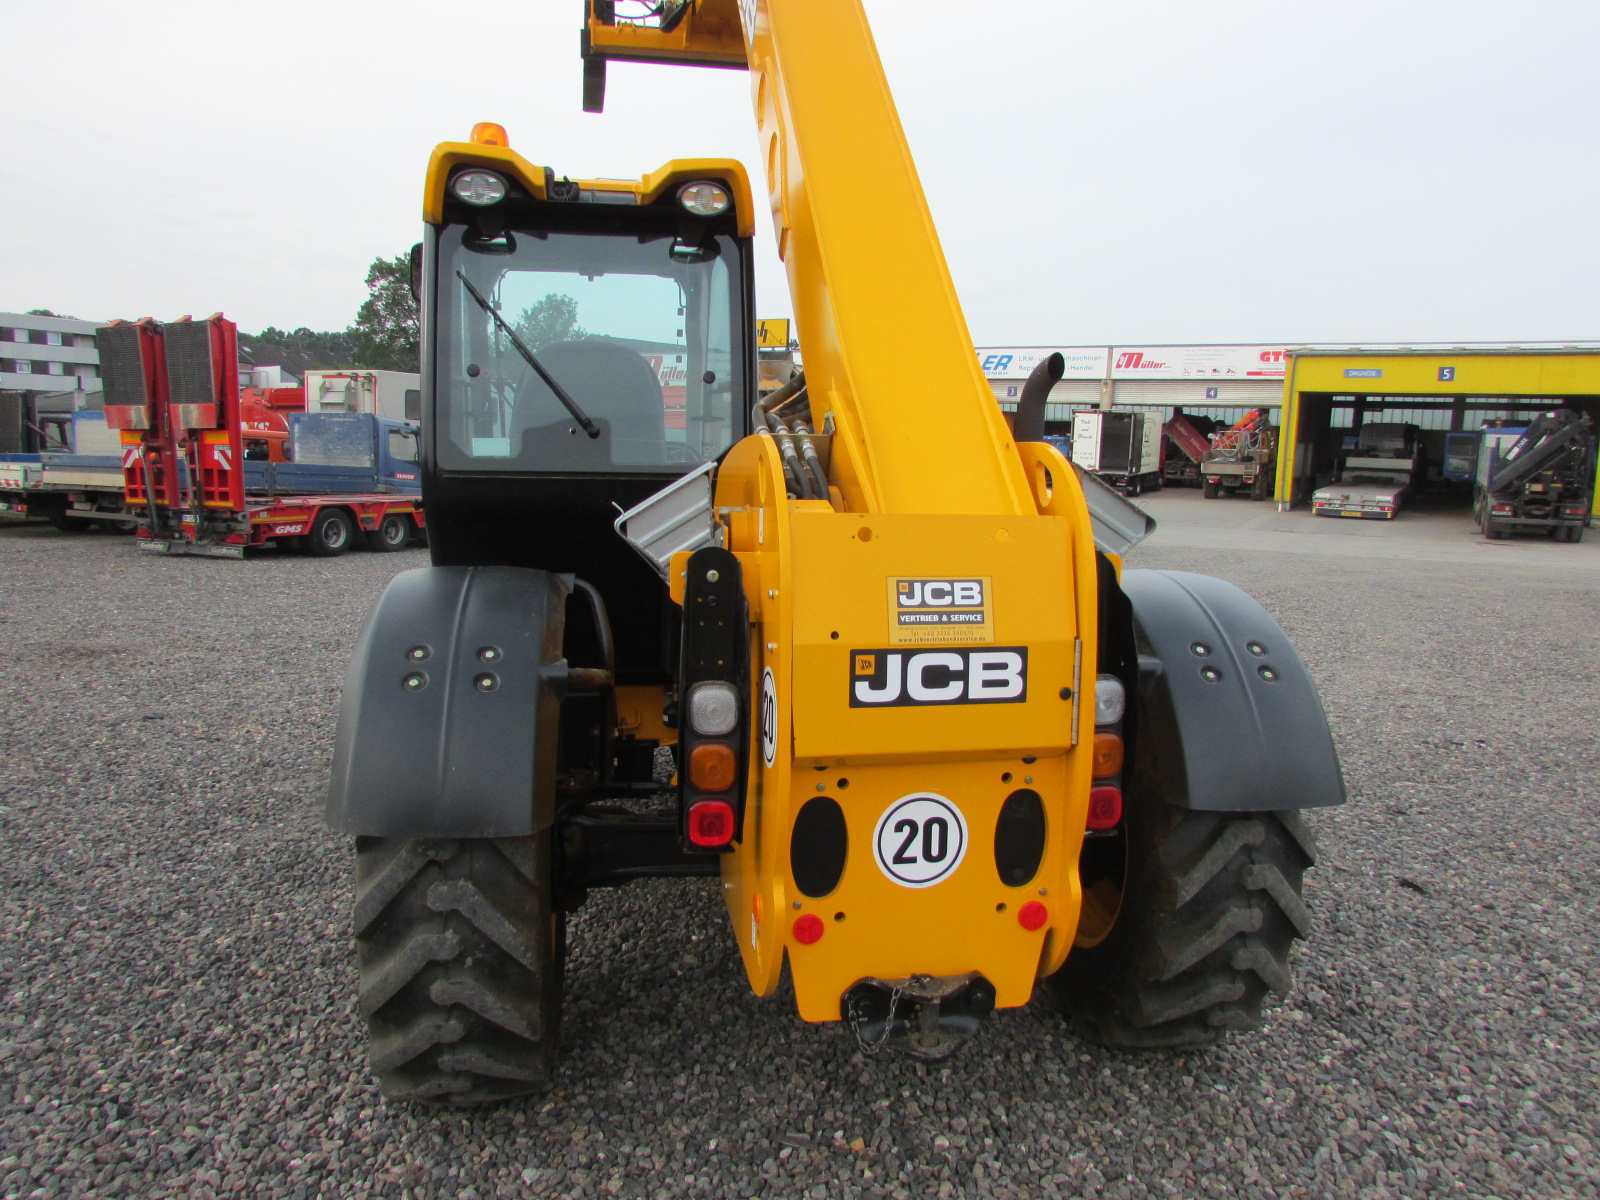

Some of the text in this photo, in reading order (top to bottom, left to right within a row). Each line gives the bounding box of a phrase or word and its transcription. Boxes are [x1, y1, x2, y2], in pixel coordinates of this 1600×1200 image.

[1115, 352, 1166, 369] Müller
[1442, 368, 1450, 380] 5
[275, 524, 303, 534] GMS
[211, 547, 240, 555] Goldhofer
[899, 582, 982, 606] JCB
[899, 614, 983, 622] VERTRIEB & SERVICE
[855, 652, 1023, 702] JCB
[763, 690, 774, 745] 20
[892, 816, 948, 865] 20
